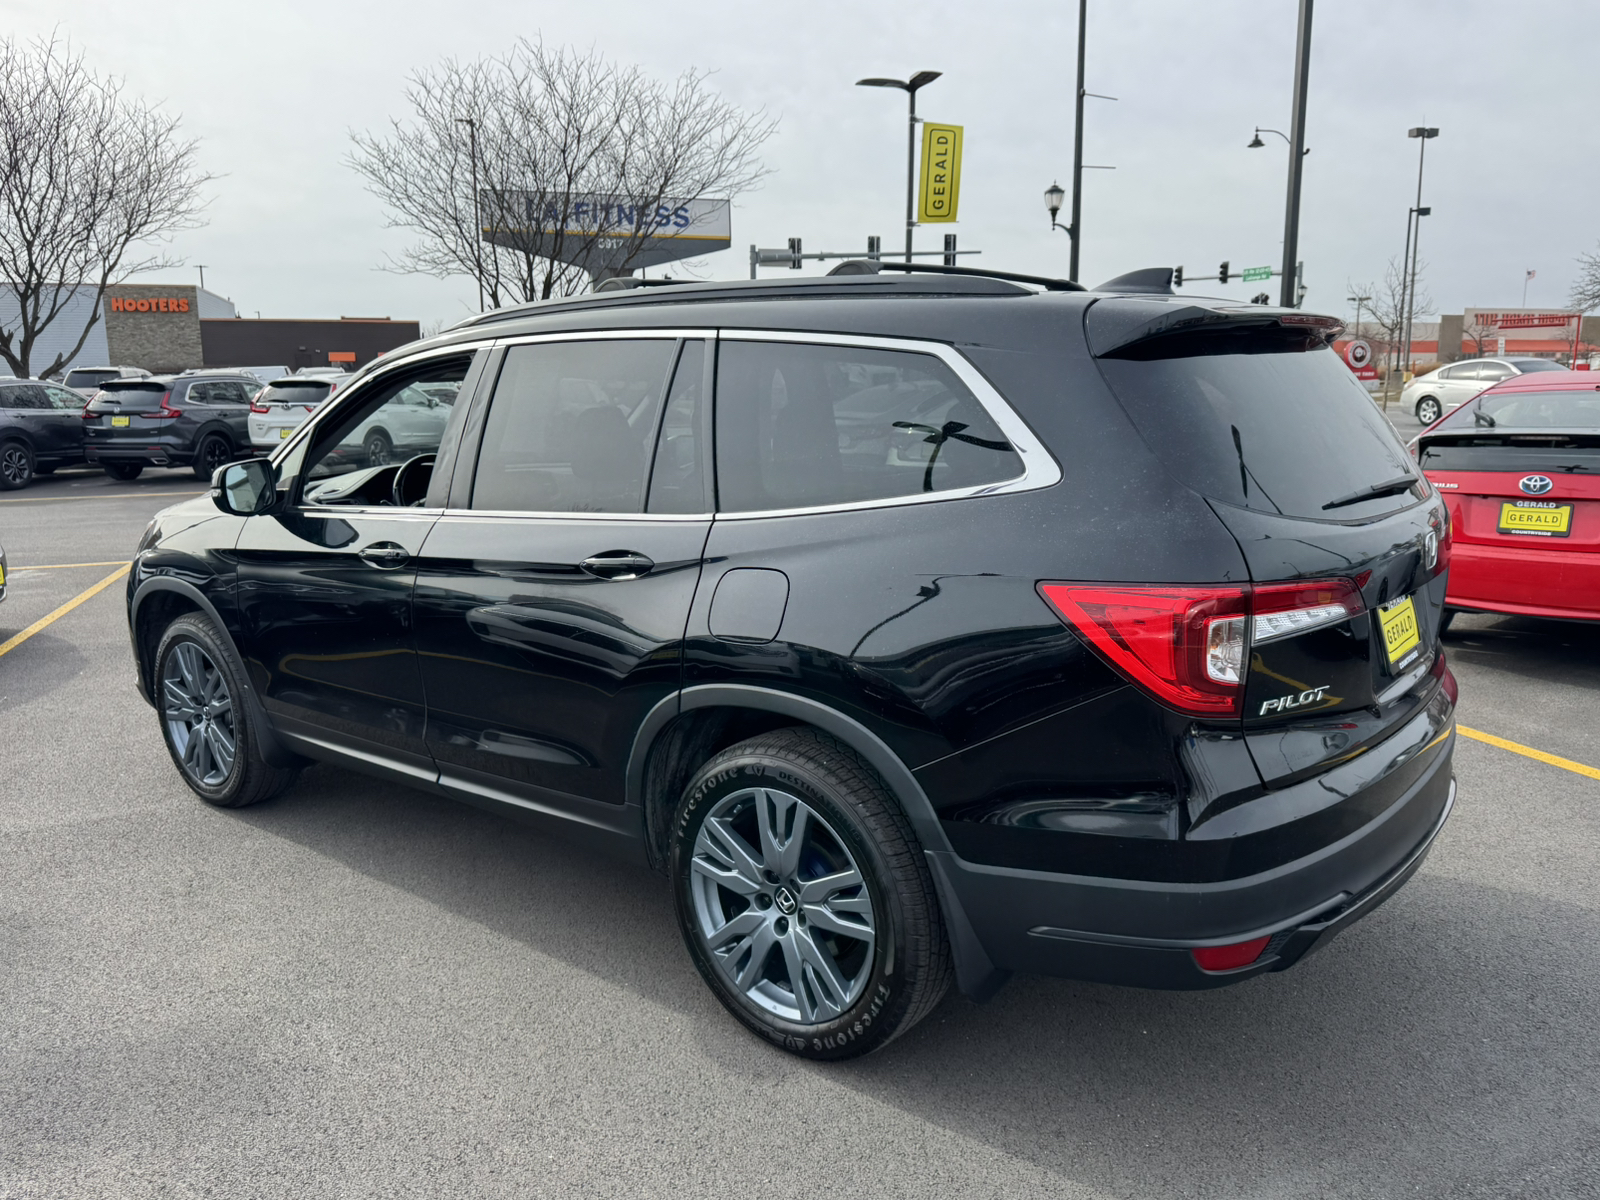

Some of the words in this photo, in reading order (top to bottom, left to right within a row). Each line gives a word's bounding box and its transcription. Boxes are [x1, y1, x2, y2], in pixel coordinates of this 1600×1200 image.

[932, 135, 949, 210] GERALD
[574, 201, 690, 229] FITNESS
[598, 238, 624, 249] 5917
[111, 297, 189, 312] HOOTERS
[1509, 513, 1560, 524] GERALD
[1516, 500, 1557, 509] GERALD
[1386, 615, 1413, 645] GERALD
[1259, 685, 1331, 716] PILOT
[813, 982, 891, 1051] Firestone
